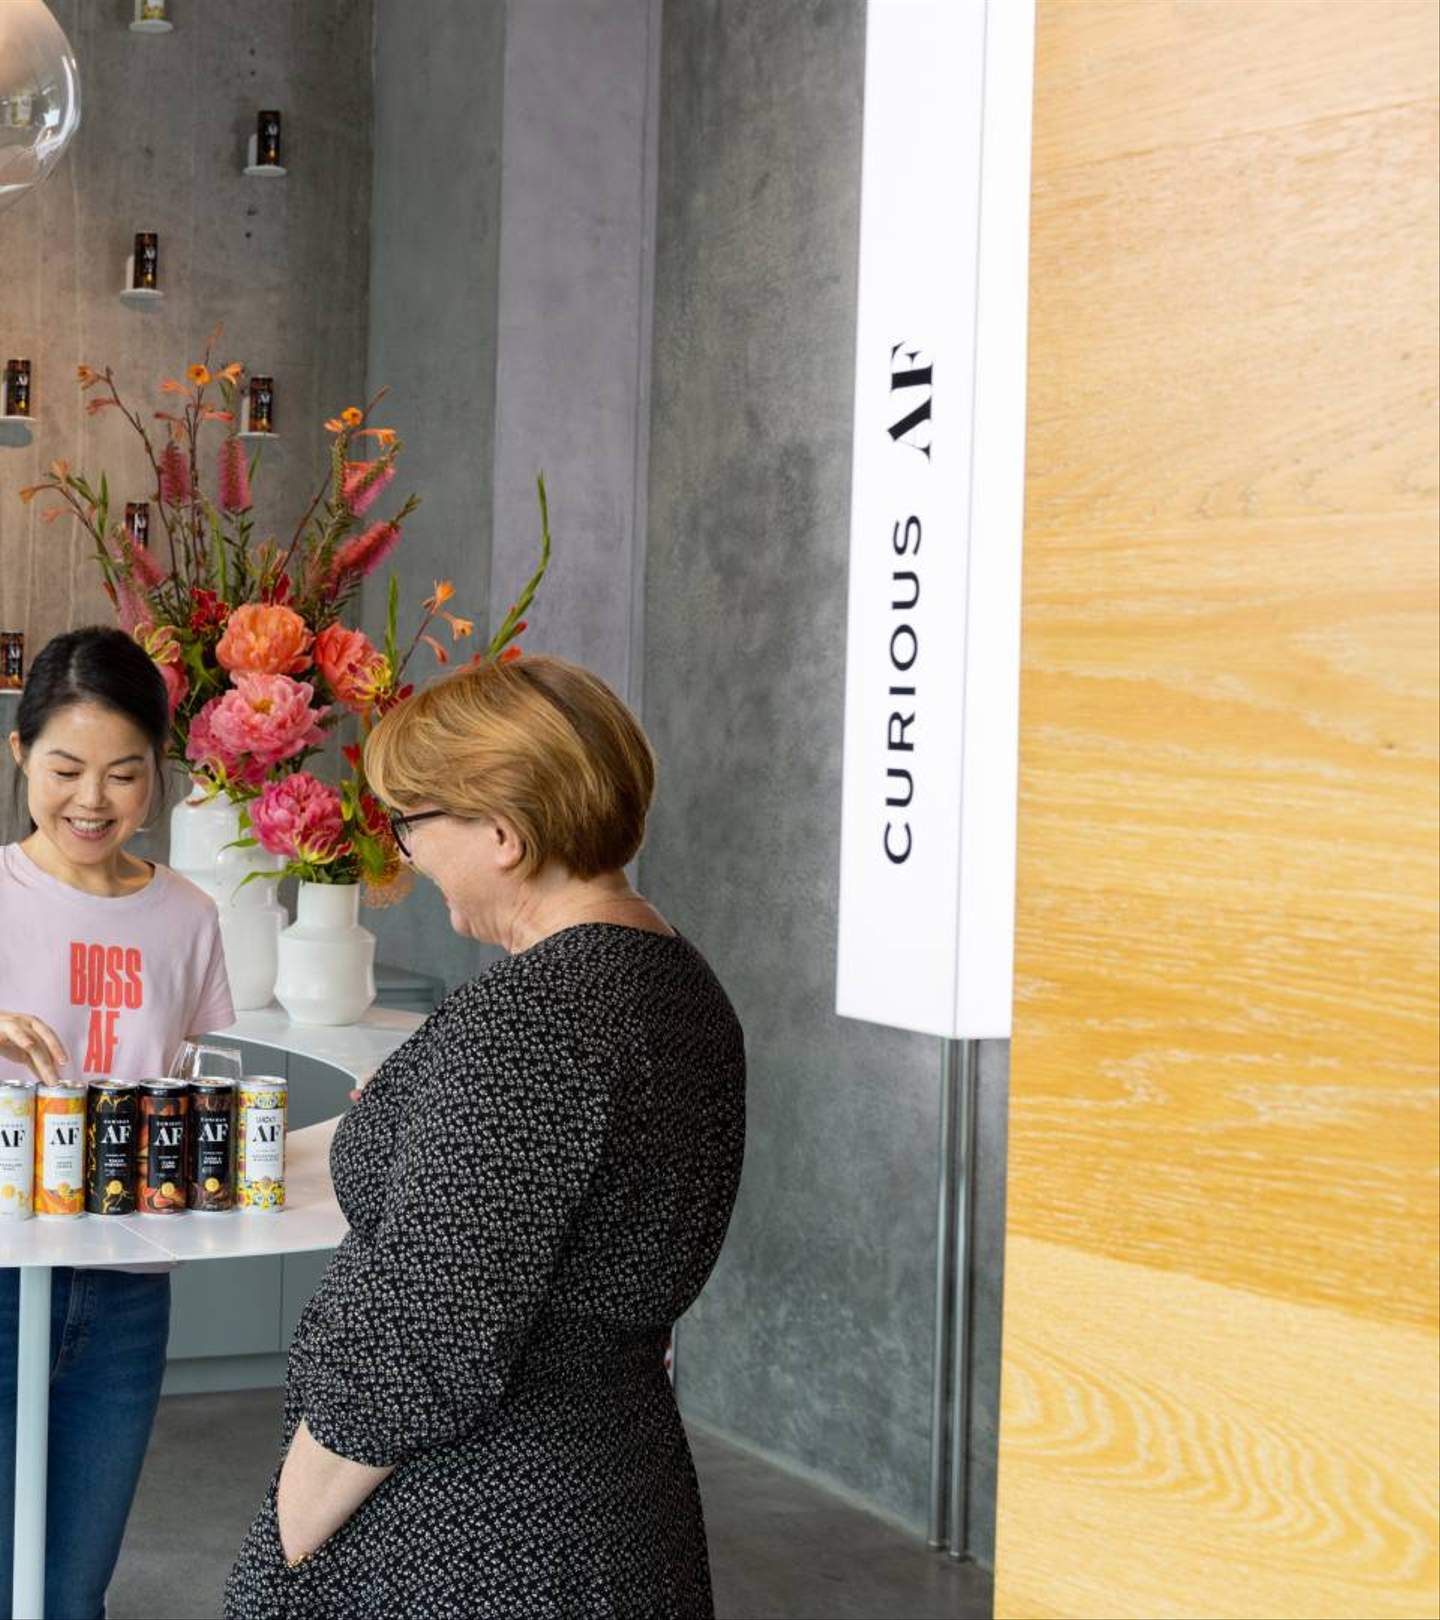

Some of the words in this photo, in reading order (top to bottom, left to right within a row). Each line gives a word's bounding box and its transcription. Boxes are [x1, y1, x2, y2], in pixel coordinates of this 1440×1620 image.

[887, 339, 934, 464] AF
[884, 514, 923, 866] CURIOUS
[71, 942, 142, 1009] BOSS
[83, 1010, 120, 1073] AF
[51, 1128, 80, 1145] AF
[101, 1126, 132, 1144] AF
[154, 1127, 183, 1146] AF
[199, 1123, 228, 1141] AF
[253, 1125, 280, 1142] AF
